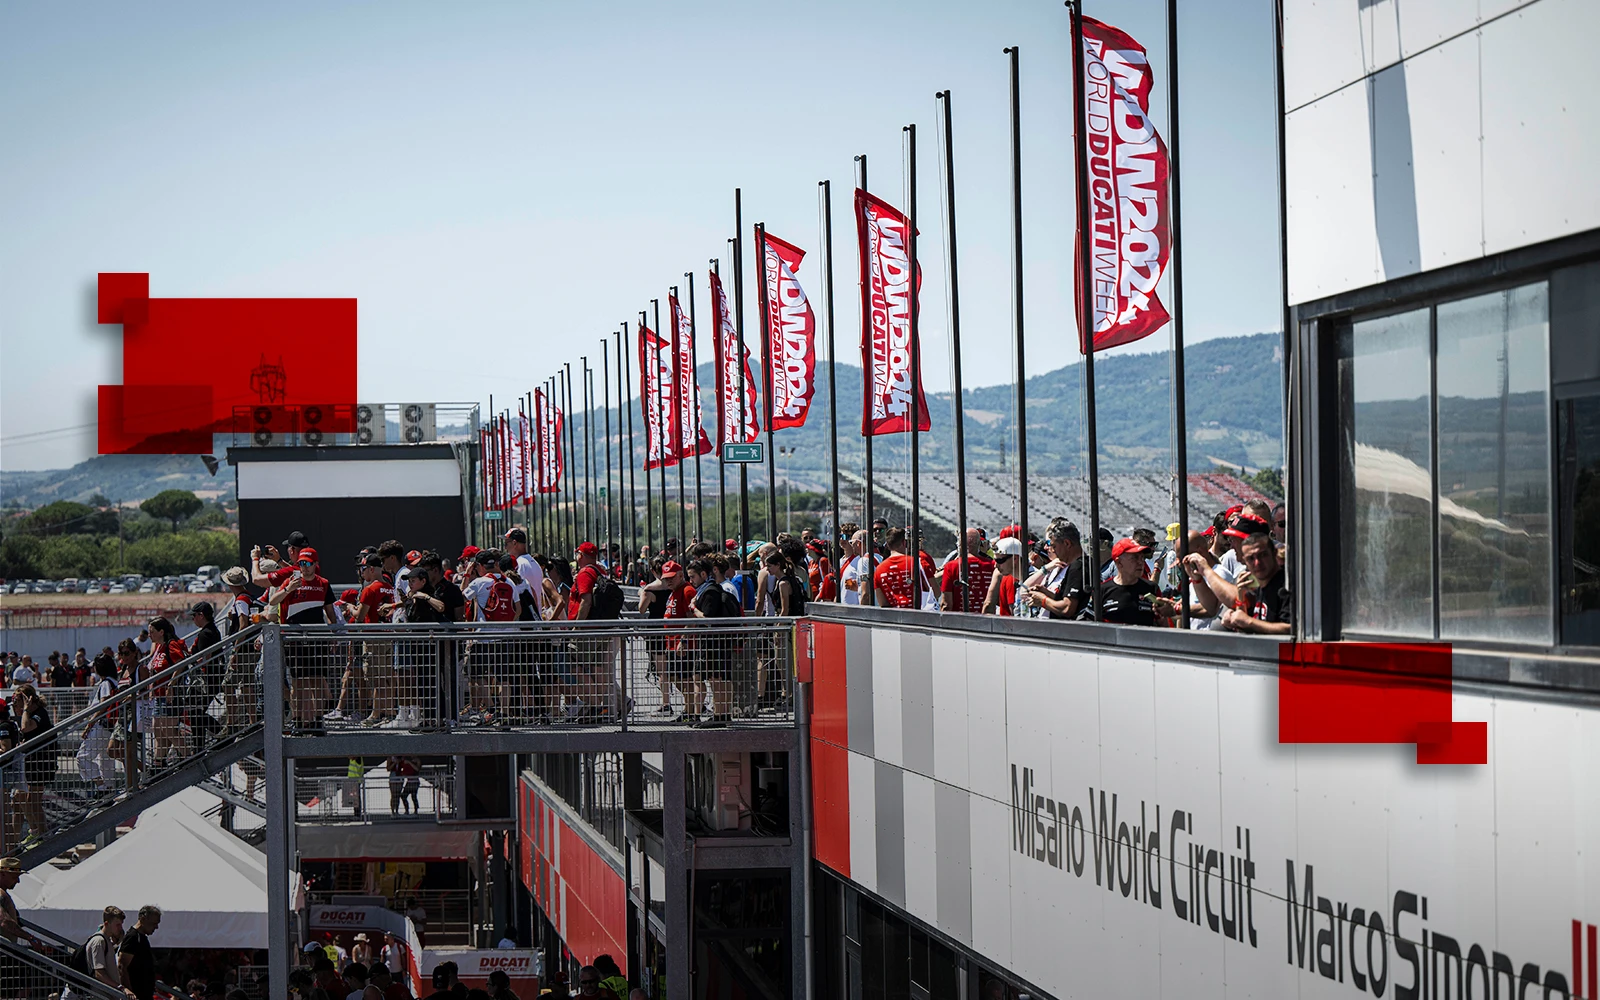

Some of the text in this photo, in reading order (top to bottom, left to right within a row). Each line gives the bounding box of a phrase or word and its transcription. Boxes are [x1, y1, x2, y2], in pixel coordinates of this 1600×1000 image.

[877, 216, 912, 418] WDW2024
[1011, 763, 1085, 878] Misano
[1089, 787, 1162, 910] World
[1170, 809, 1258, 949] Circuit
[320, 911, 366, 921] DUCATI
[480, 957, 530, 967] DUCATI
